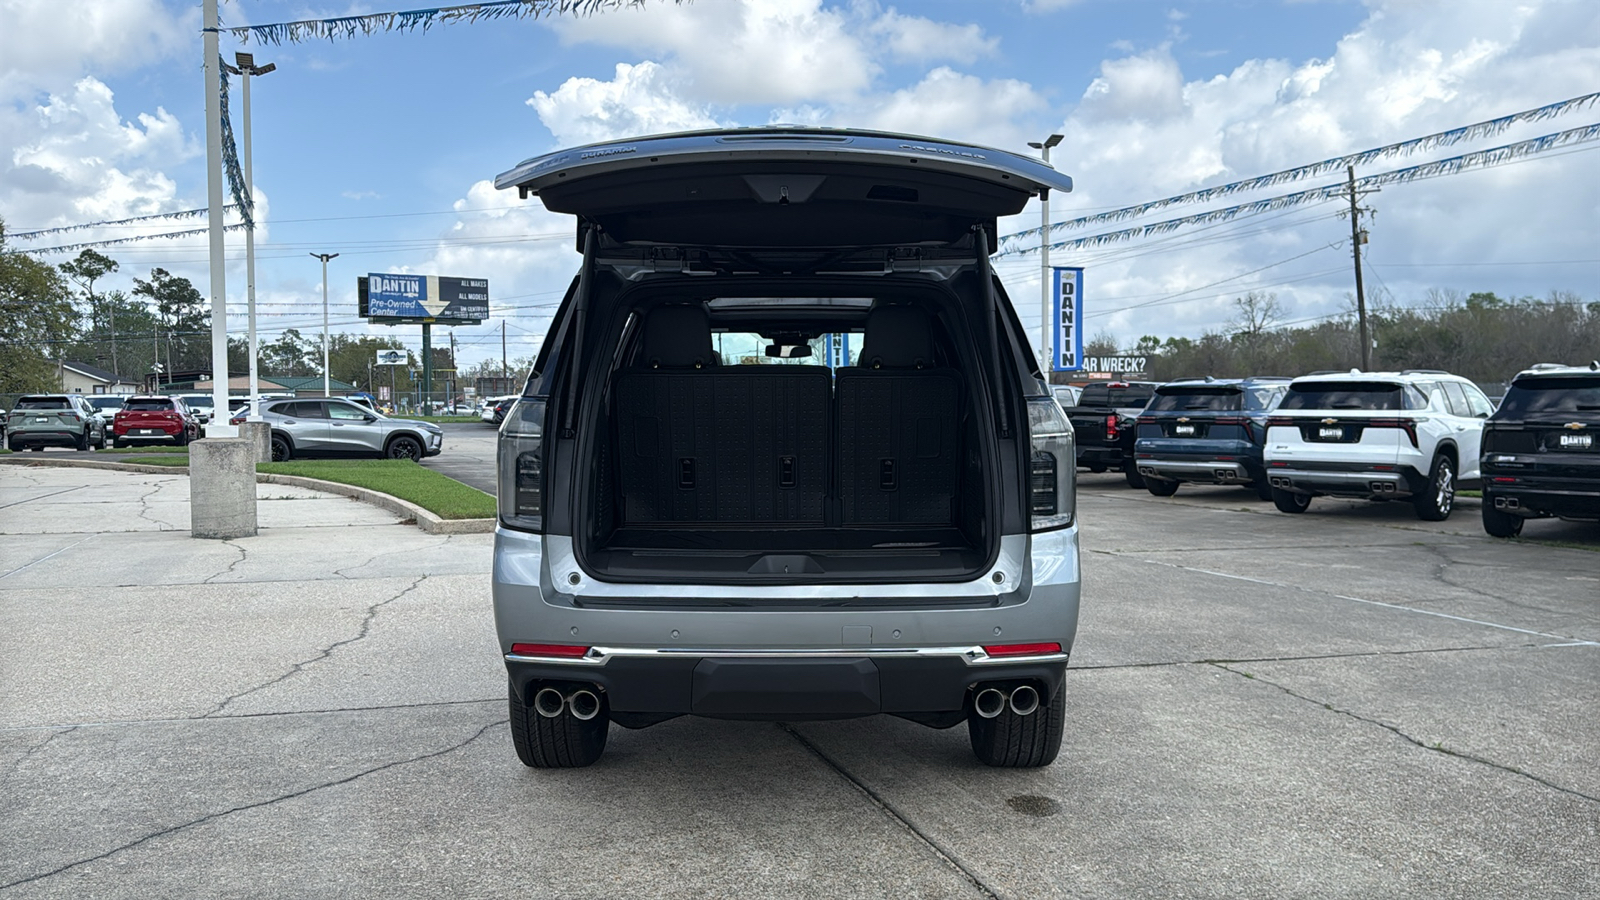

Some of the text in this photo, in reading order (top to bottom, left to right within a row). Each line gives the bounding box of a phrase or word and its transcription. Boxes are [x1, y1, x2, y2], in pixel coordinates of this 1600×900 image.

[580, 146, 637, 160] DURAMAX
[899, 144, 986, 160] PREMIER
[370, 275, 419, 293] DANTIN
[470, 280, 487, 288] MAKES
[468, 293, 487, 301] MODELS
[370, 298, 416, 309] Pre-Owned
[370, 307, 399, 316] Center
[1061, 282, 1074, 367] DANTIN
[1079, 357, 1146, 372] AR WRECK?
[1560, 435, 1592, 445] DANTIN
